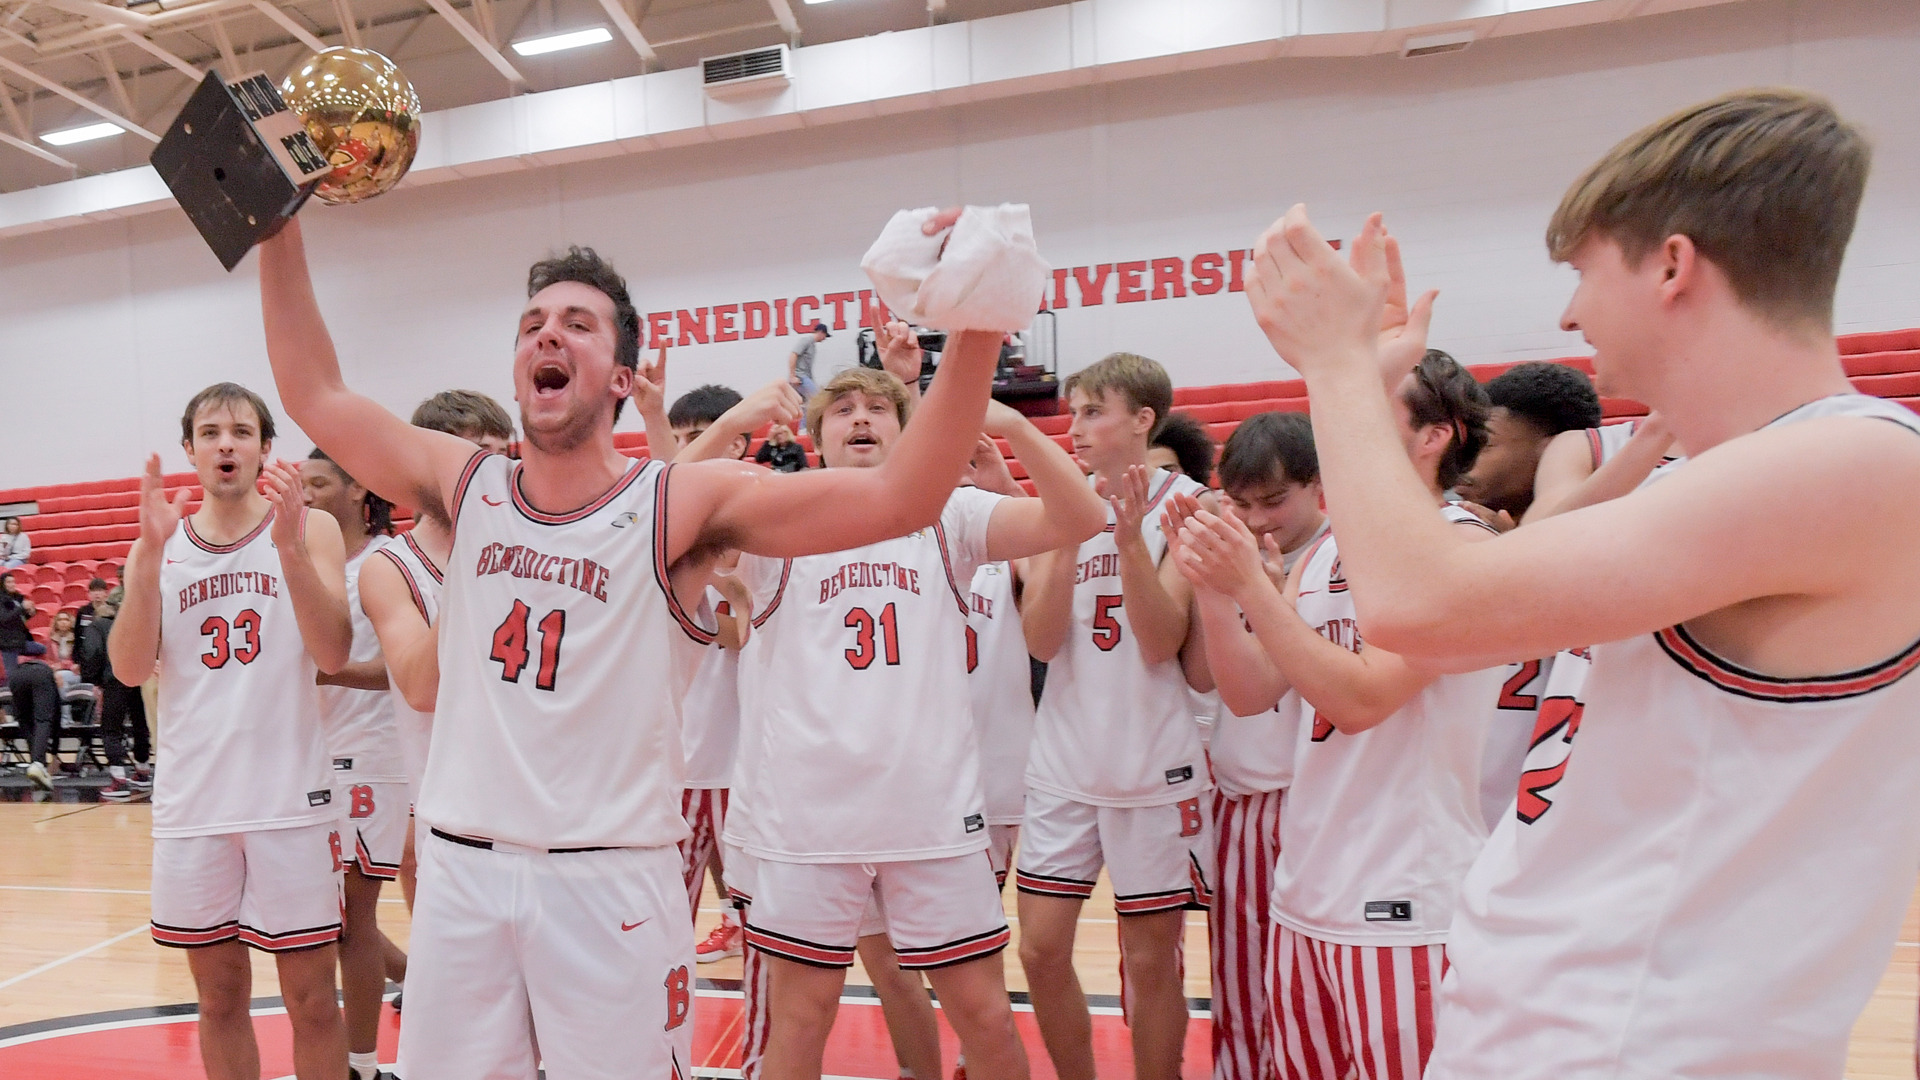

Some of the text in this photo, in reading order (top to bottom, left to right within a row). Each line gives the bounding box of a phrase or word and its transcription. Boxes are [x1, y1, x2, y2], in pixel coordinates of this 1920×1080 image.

[637, 239, 1342, 349] ENEDICTI IVERSI
[179, 571, 278, 614] BENEDICTINE
[476, 542, 610, 603] BENEDICTINE
[201, 608, 262, 670] 33
[489, 598, 566, 692] 41
[844, 602, 901, 670] 31
[1092, 594, 1123, 652] 5
[349, 784, 375, 818] B
[1176, 797, 1203, 837] B
[664, 964, 690, 1032] B
